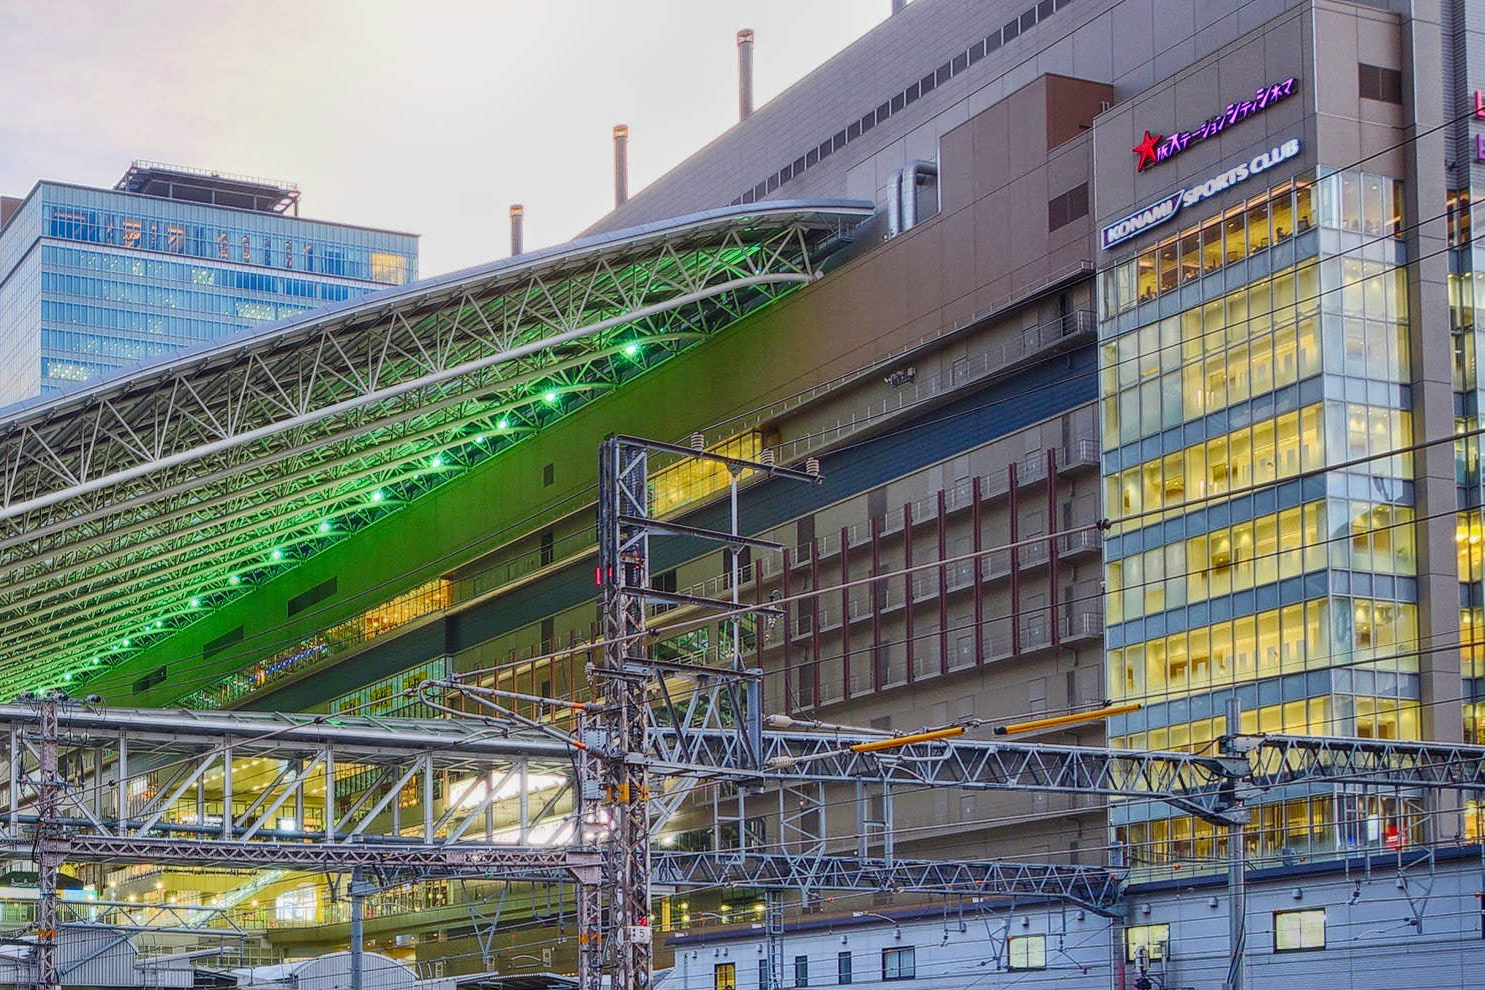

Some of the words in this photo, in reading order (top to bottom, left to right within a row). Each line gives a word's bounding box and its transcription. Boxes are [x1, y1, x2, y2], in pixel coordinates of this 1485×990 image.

[1106, 198, 1174, 245] KONAMI
[1182, 161, 1250, 209] SPORTS
[1250, 137, 1300, 176] CLUB
